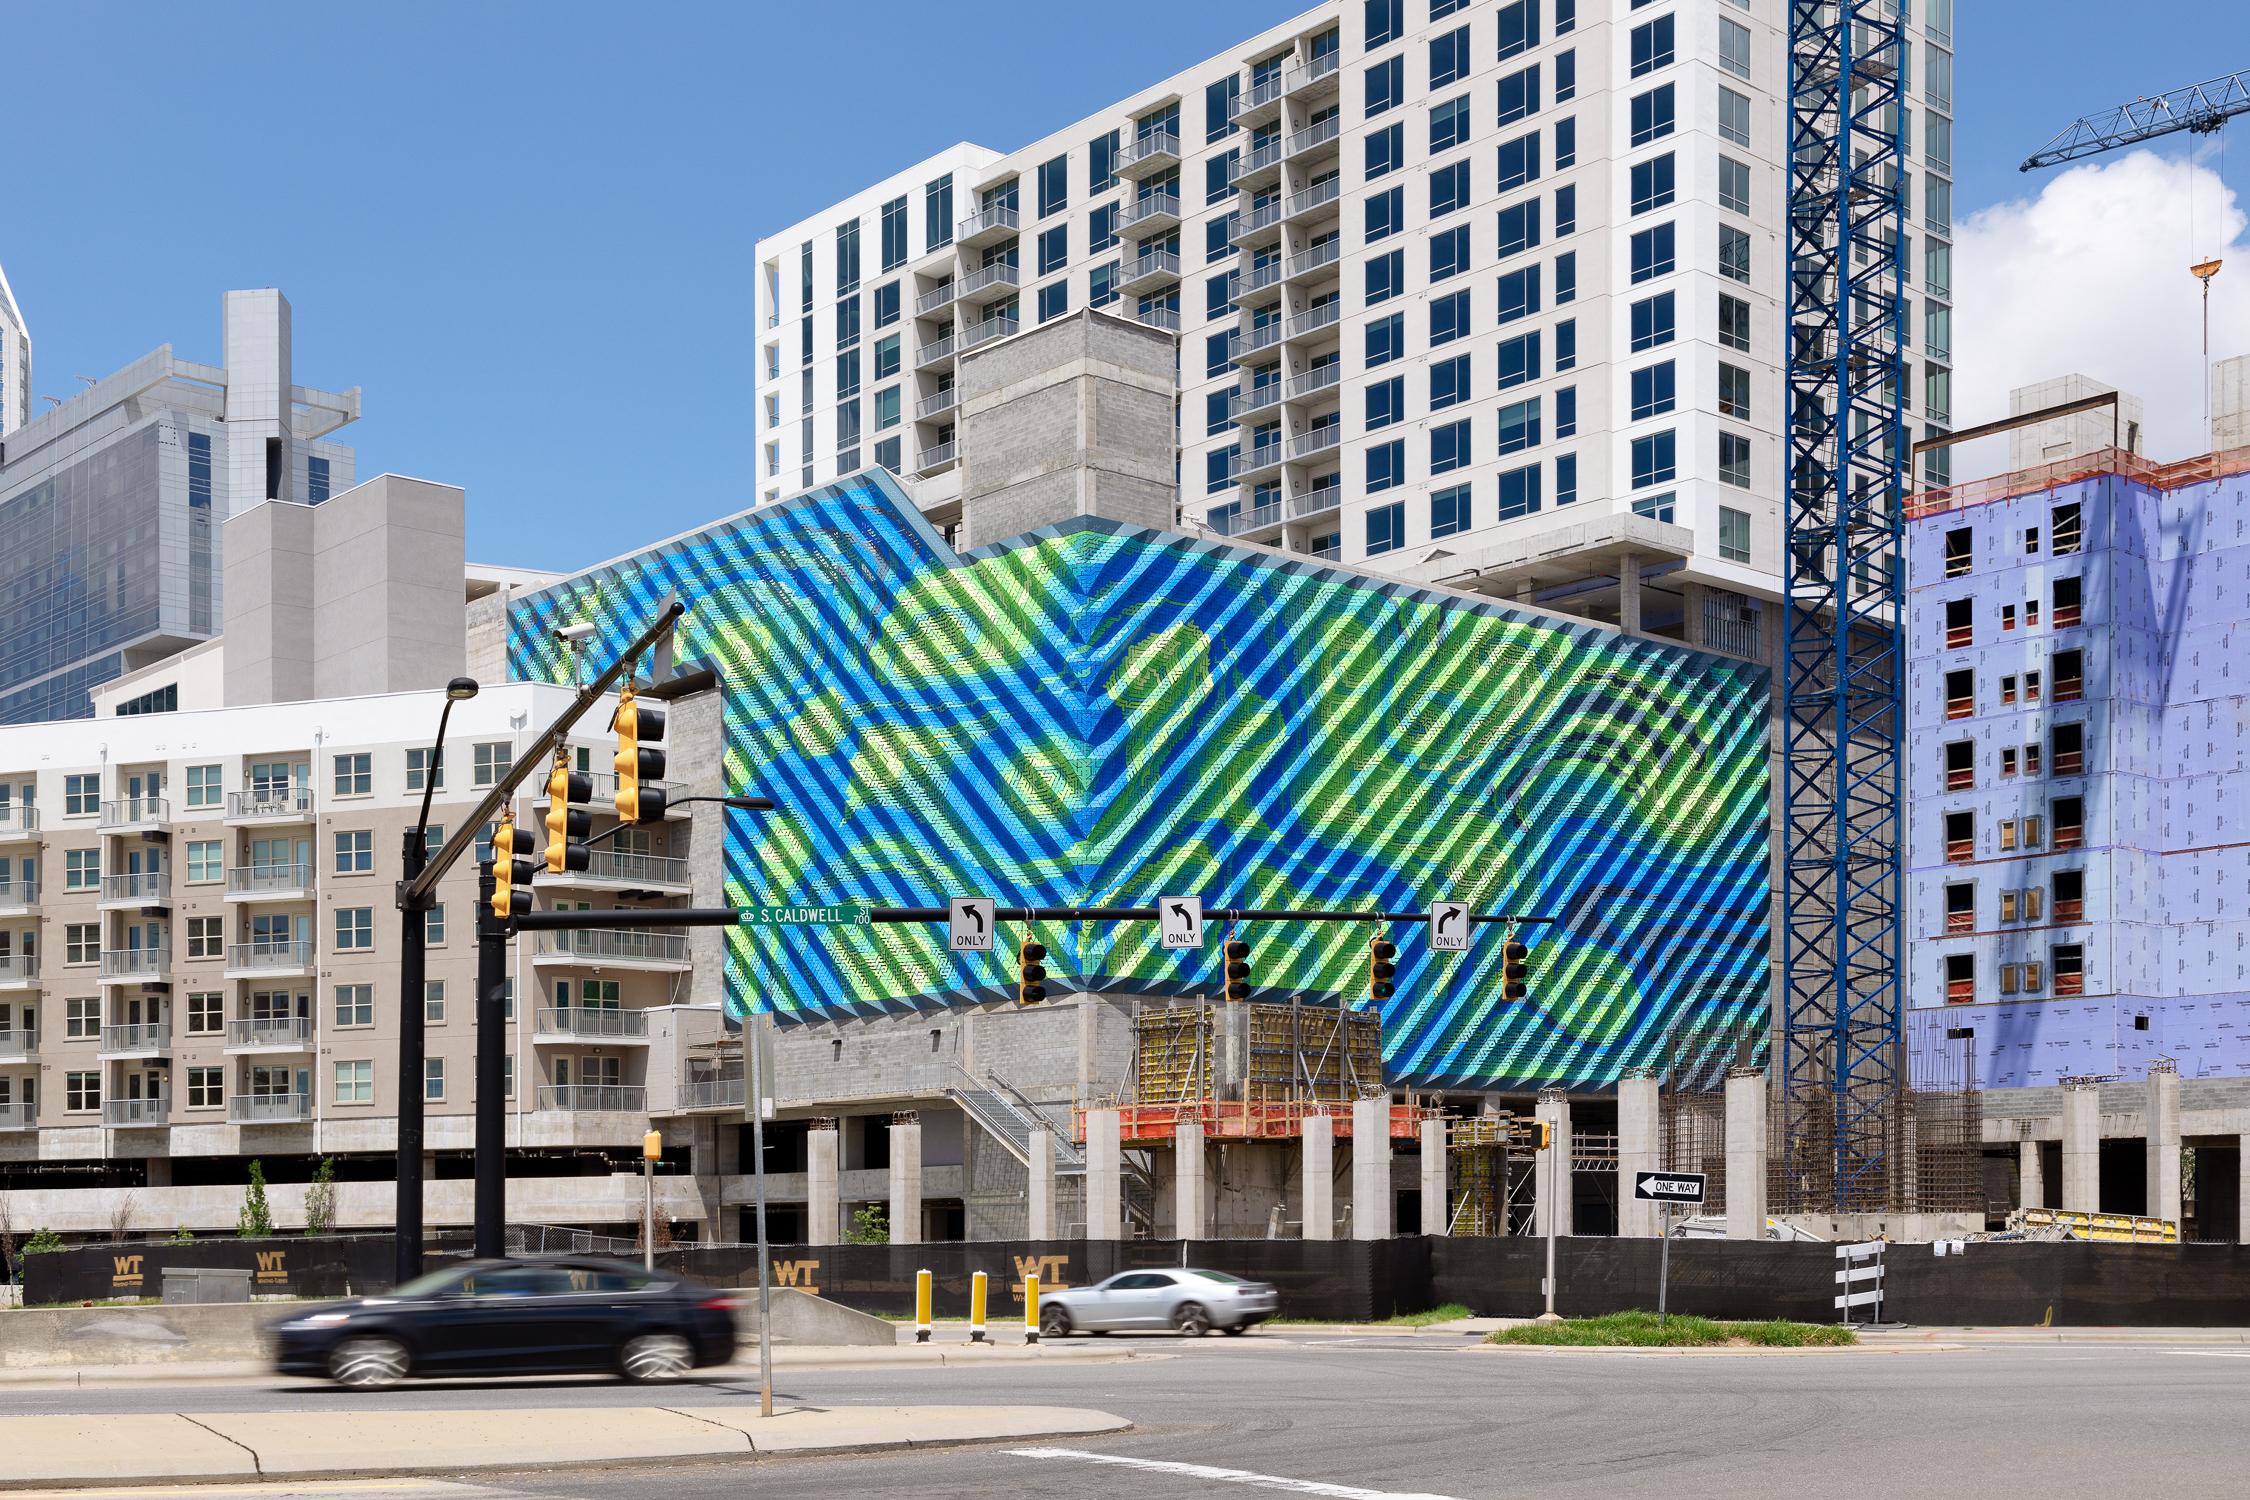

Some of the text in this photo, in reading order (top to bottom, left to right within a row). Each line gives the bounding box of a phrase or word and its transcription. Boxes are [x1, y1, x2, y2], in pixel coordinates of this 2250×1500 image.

[761, 908, 843, 922] S. CALDWELL
[860, 906, 870, 915] ST
[853, 915, 870, 925] 700
[956, 935, 987, 946] ONLY
[1168, 933, 1196, 944] ONLY
[1436, 936, 1463, 947] ONLY
[1655, 1181, 1697, 1194] ONE WAY
[113, 1254, 144, 1275] WT
[255, 1251, 286, 1271] WT
[773, 1260, 820, 1286] WT
[1013, 1255, 1069, 1284] WT
